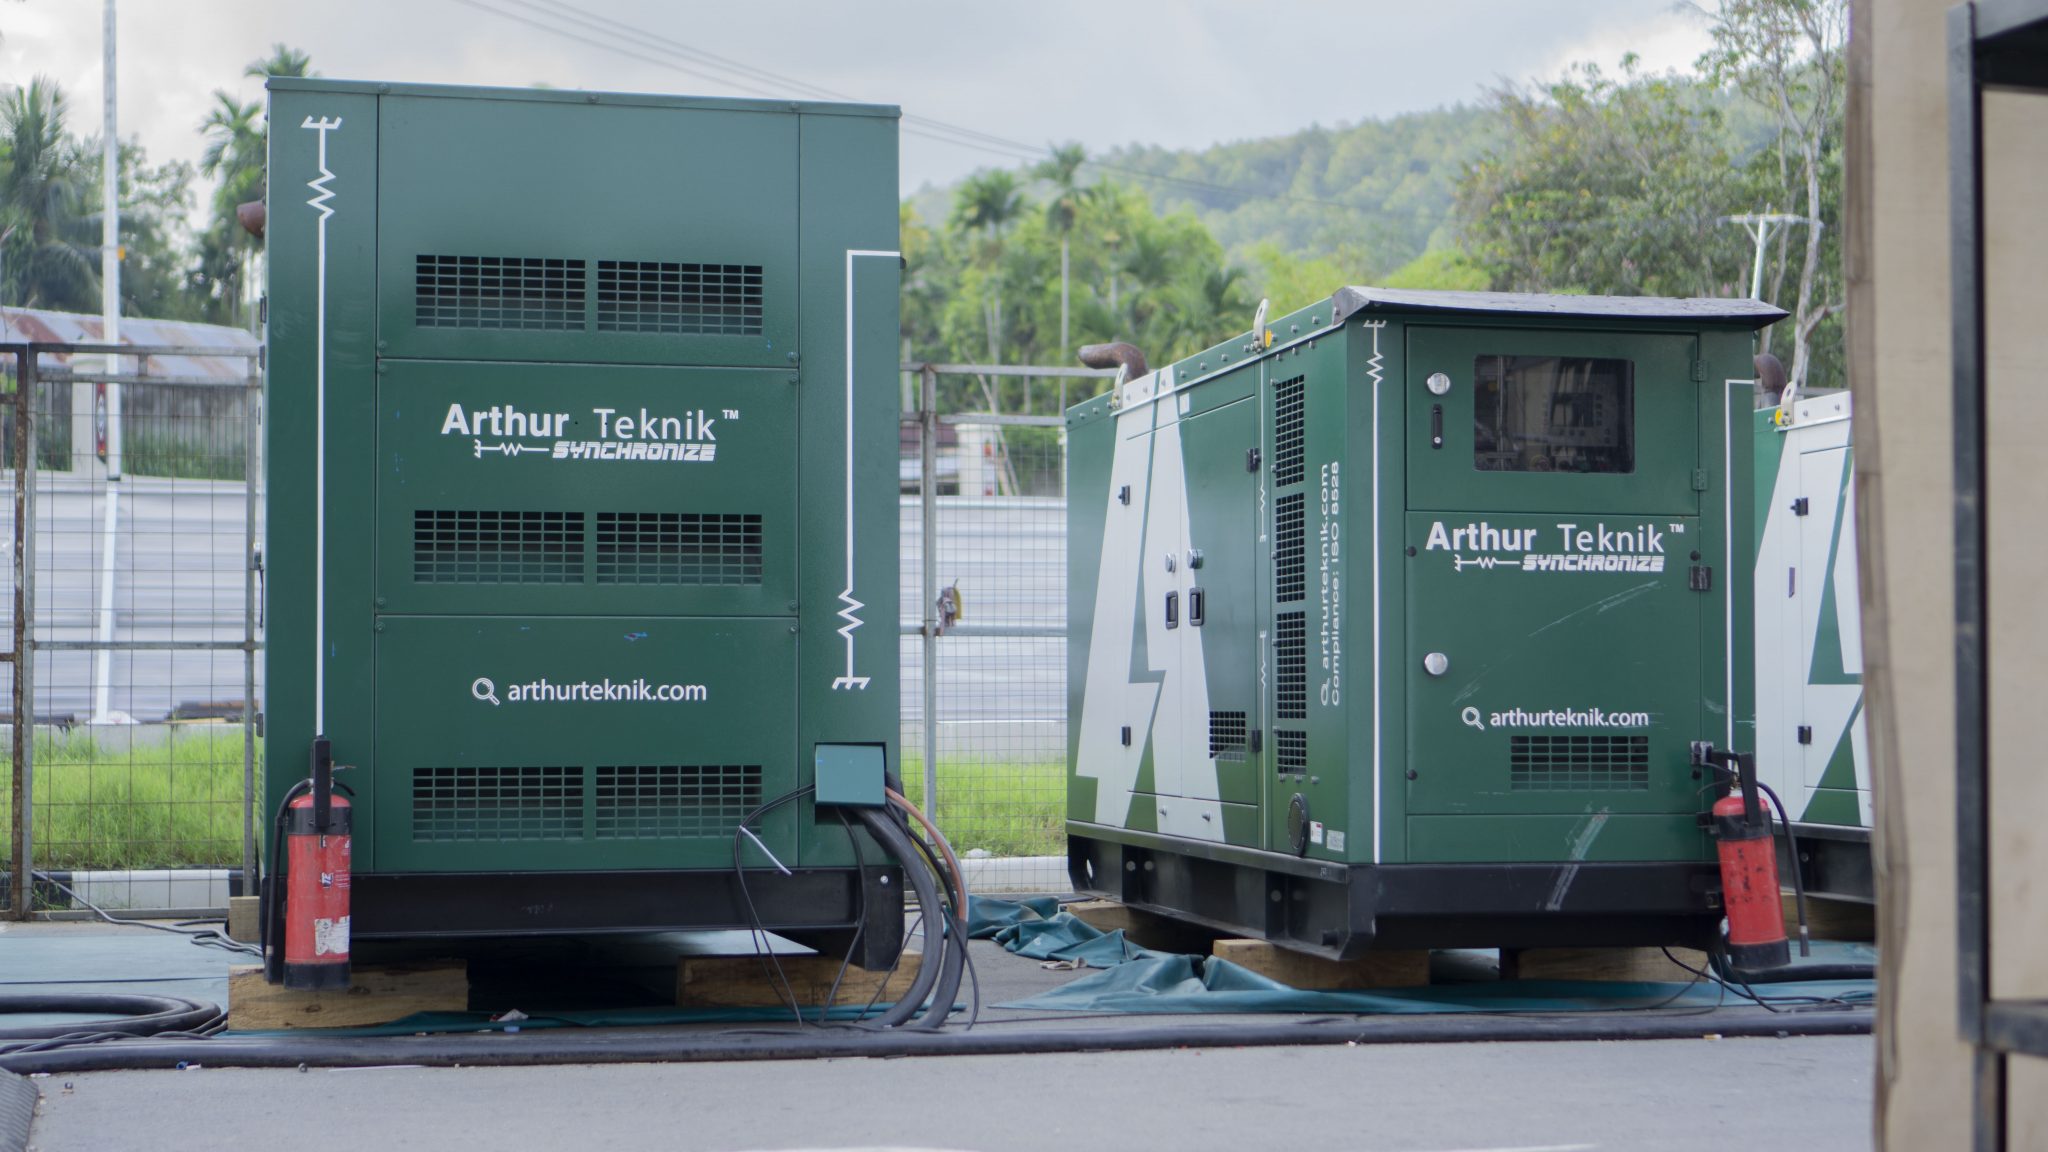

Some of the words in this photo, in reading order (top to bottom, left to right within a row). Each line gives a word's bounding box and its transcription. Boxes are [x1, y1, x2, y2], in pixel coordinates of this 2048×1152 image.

[441, 403, 570, 437] Arthur
[593, 408, 716, 441] Teknik
[552, 440, 717, 462] SYNCHRONIZE
[1331, 461, 1340, 515] 8528
[1331, 522, 1340, 563] ISO
[1425, 521, 1538, 551] Arthur
[1556, 522, 1665, 553] Teknik
[1319, 463, 1330, 670] arthurteknik.com
[1522, 554, 1665, 572] SYNCHRONIZE
[1331, 570, 1342, 706] Compliance:
[507, 678, 707, 702] arthurteknik.com
[1490, 707, 1649, 727] arthurteknik.com
